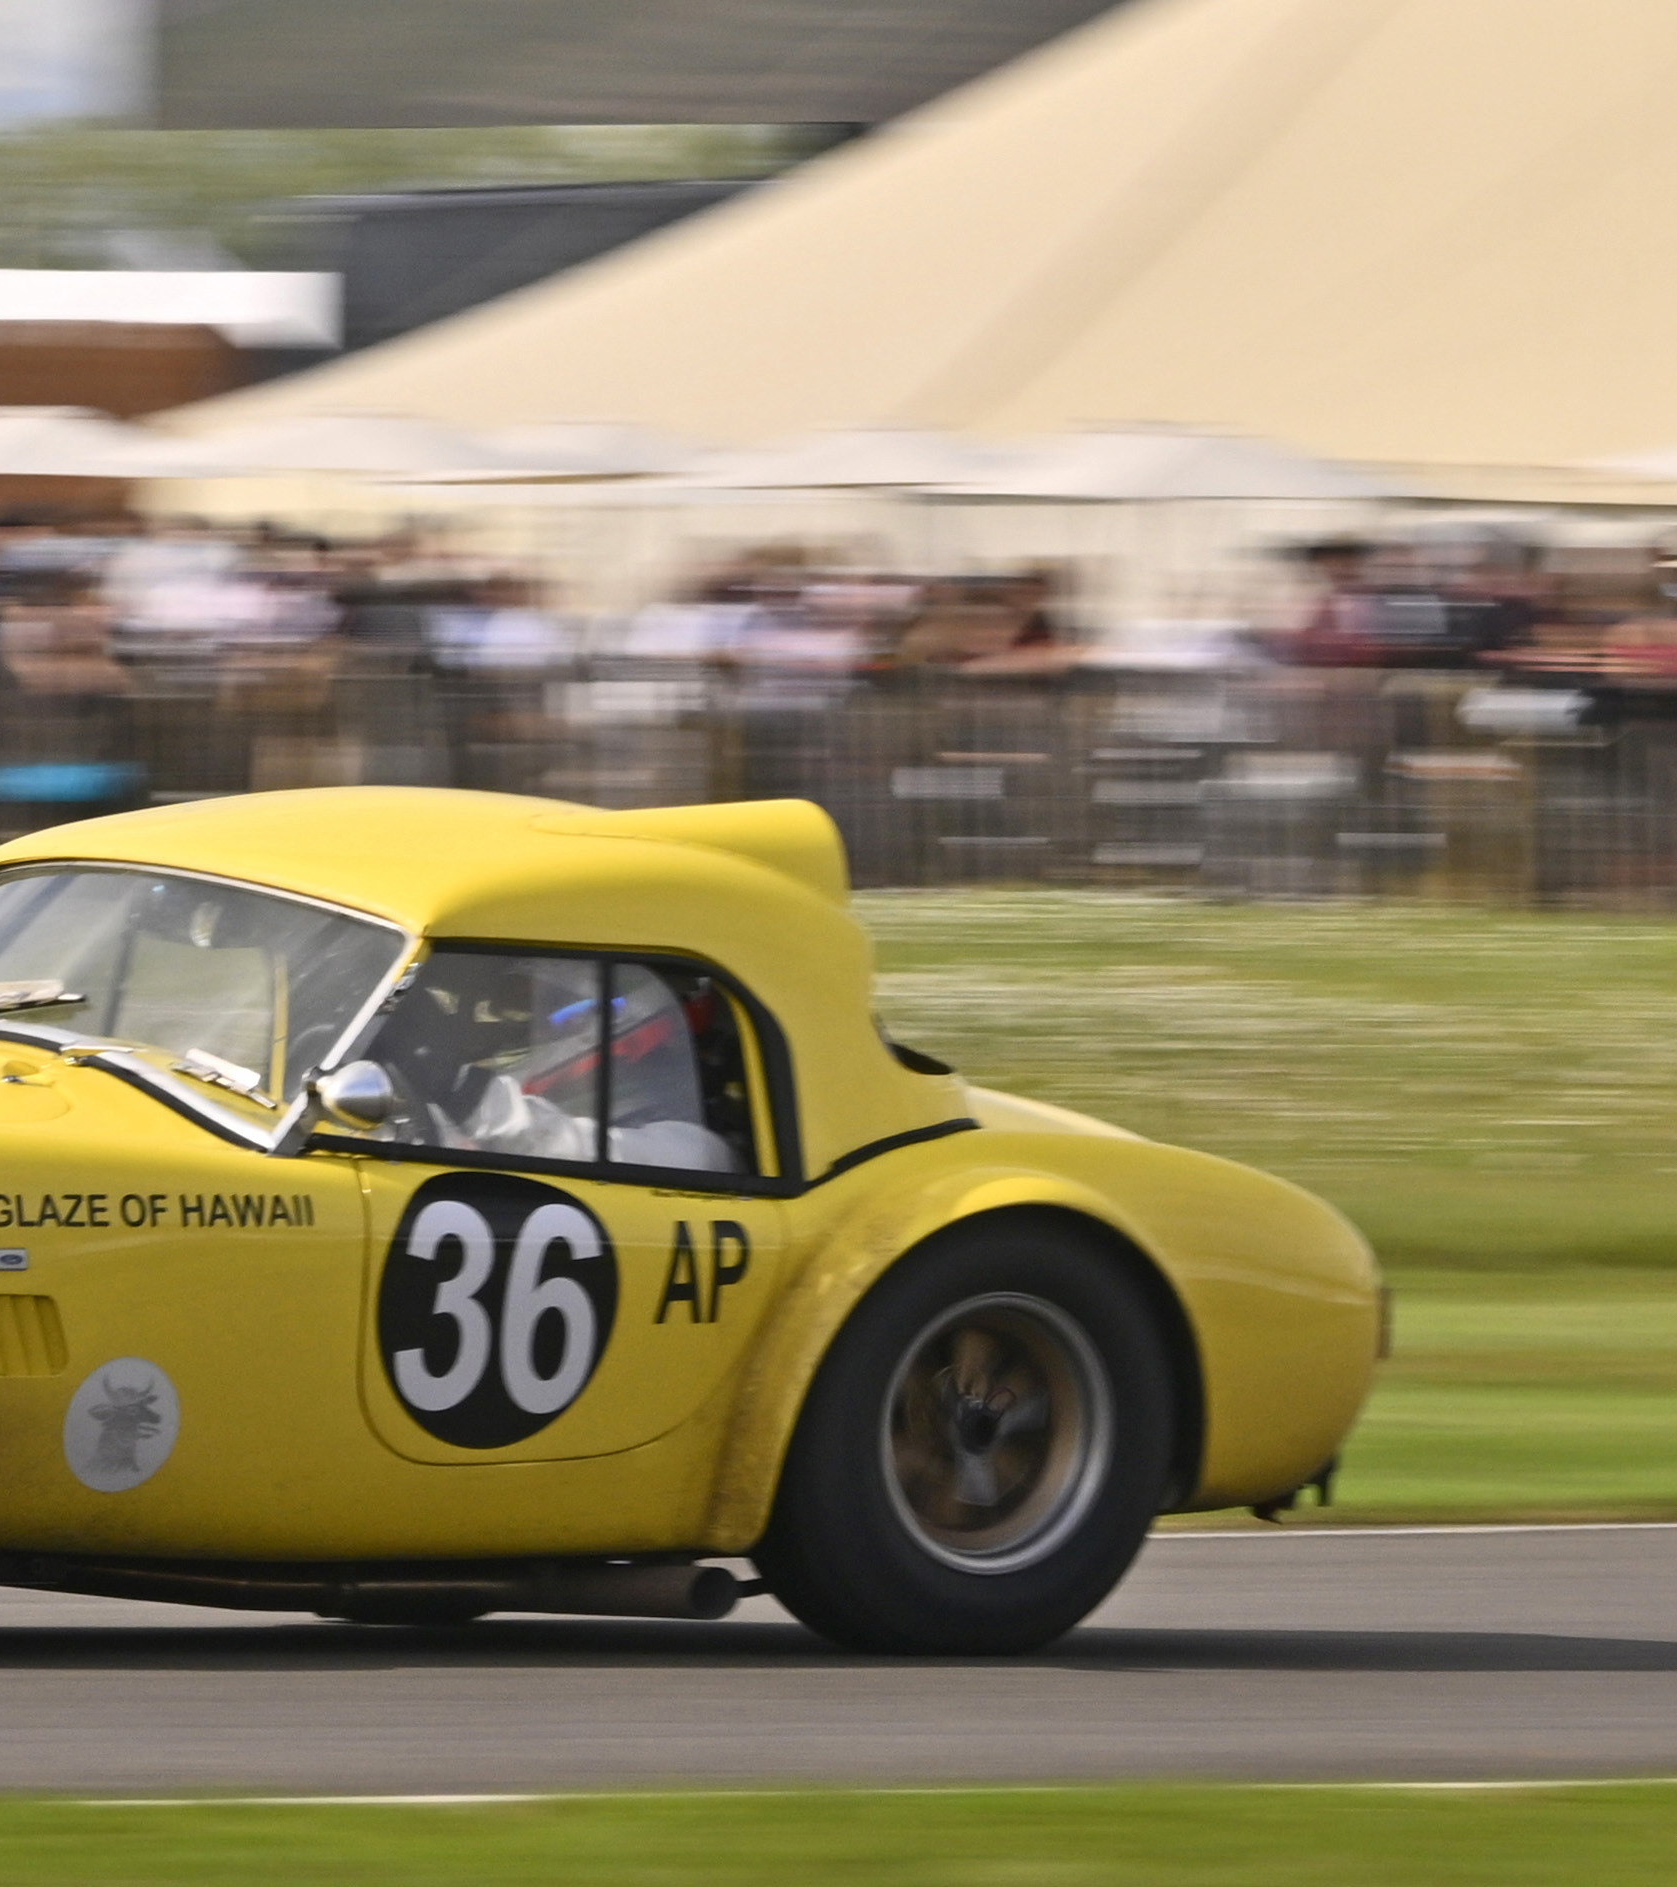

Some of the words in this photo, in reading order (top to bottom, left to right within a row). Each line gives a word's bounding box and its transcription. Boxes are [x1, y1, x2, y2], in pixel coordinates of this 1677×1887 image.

[119, 1194, 168, 1228] OF
[179, 1194, 314, 1228] HAWAII
[392, 1200, 603, 1415] 36
[653, 1220, 751, 1325] AP
